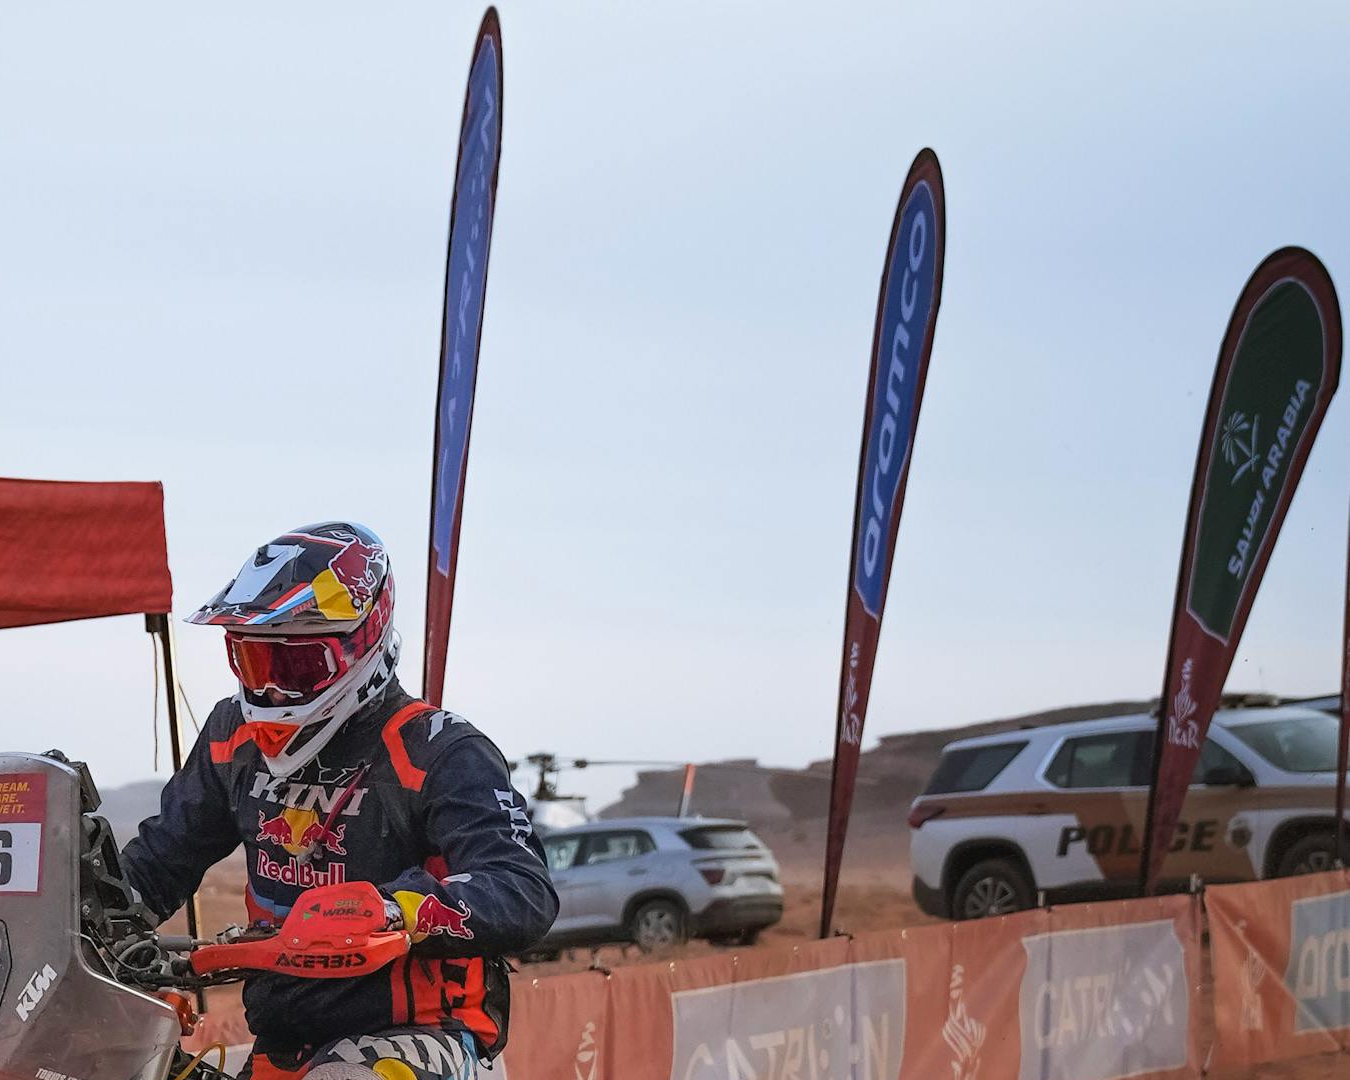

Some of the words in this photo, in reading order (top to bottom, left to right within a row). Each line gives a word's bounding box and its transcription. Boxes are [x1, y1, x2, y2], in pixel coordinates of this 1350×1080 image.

[863, 210, 926, 578] aramco
[1228, 489, 1266, 579] SAUDI
[1261, 379, 1312, 490] ARABIA
[11, 804, 25, 814] IT.
[1056, 819, 1218, 857] POLCE
[256, 849, 297, 886] Red
[298, 861, 346, 888] Bull
[15, 963, 58, 1022] KTM
